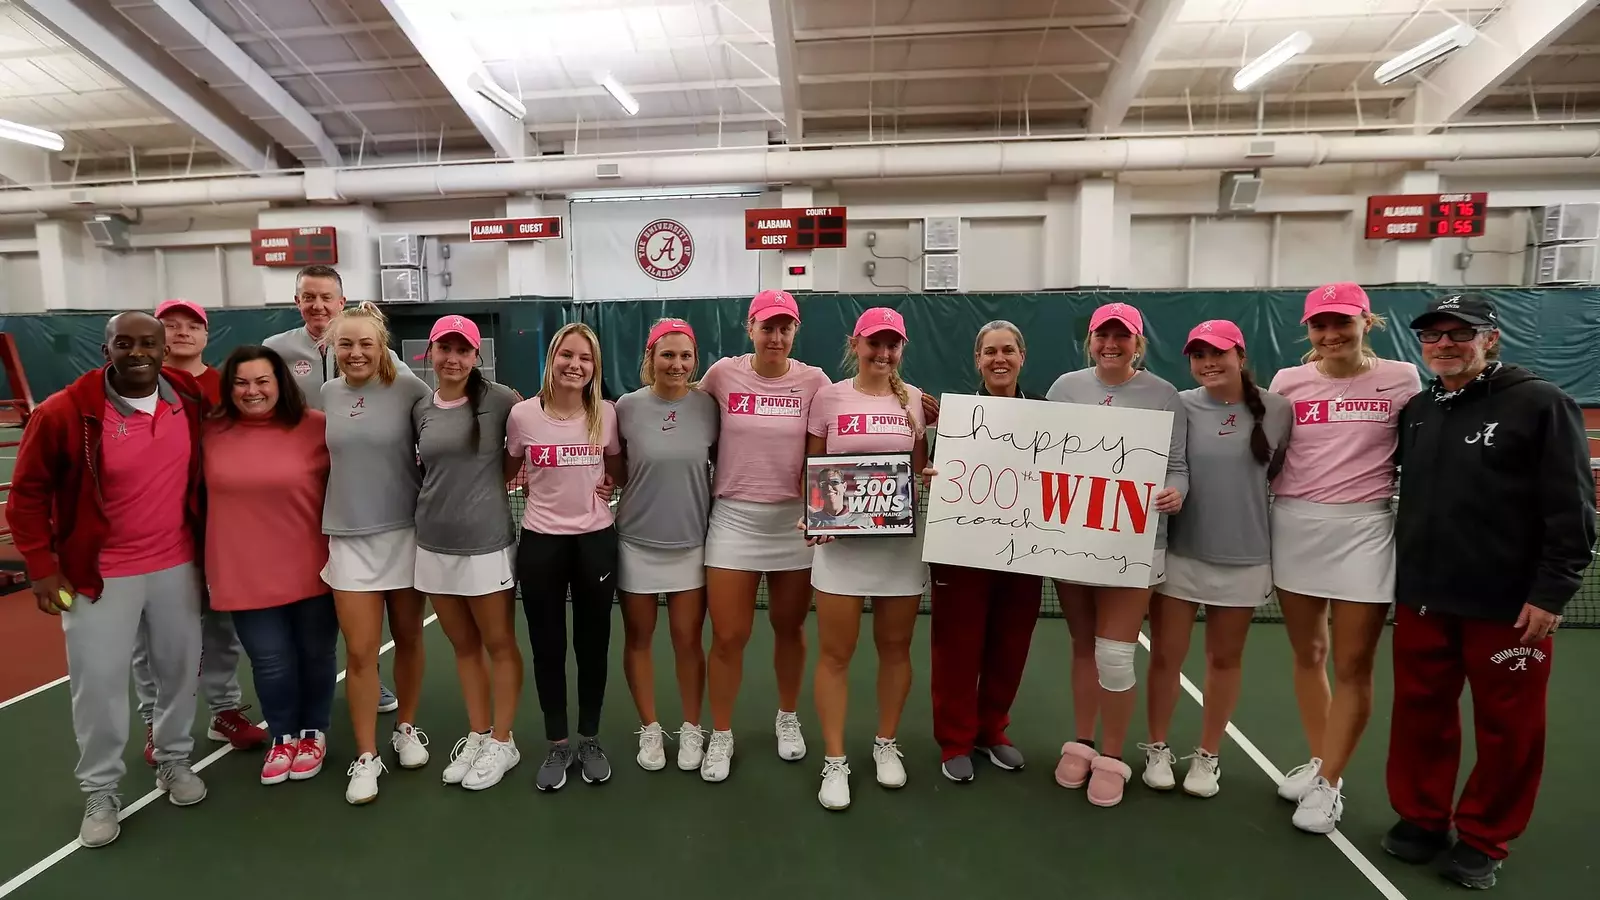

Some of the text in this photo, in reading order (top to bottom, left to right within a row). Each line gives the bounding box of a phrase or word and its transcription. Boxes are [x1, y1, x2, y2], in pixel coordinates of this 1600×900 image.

[1383, 206, 1424, 217] ALABAMA
[1439, 204, 1449, 216] 4
[473, 223, 544, 235] ALABAMA GUEST
[757, 219, 792, 229] ALABAMA
[1386, 223, 1418, 234] GUEST
[261, 237, 289, 247] ALABAMA
[638, 222, 691, 258] THE UNIVERSITY OF
[761, 235, 788, 245] GUEST
[264, 252, 286, 262] GUEST
[646, 263, 686, 278] ALABAMA
[760, 397, 800, 408] POWER
[1335, 401, 1389, 412] POWER
[871, 416, 912, 427] POWER
[936, 404, 1168, 475] happy
[561, 446, 601, 456] POWER
[853, 478, 897, 496] 300
[848, 494, 906, 513] WINS
[1038, 470, 1157, 535] WIN
[928, 508, 1066, 534] coach
[996, 533, 1152, 574] jenny
[1490, 647, 1547, 664] CRIMSON TIDE
